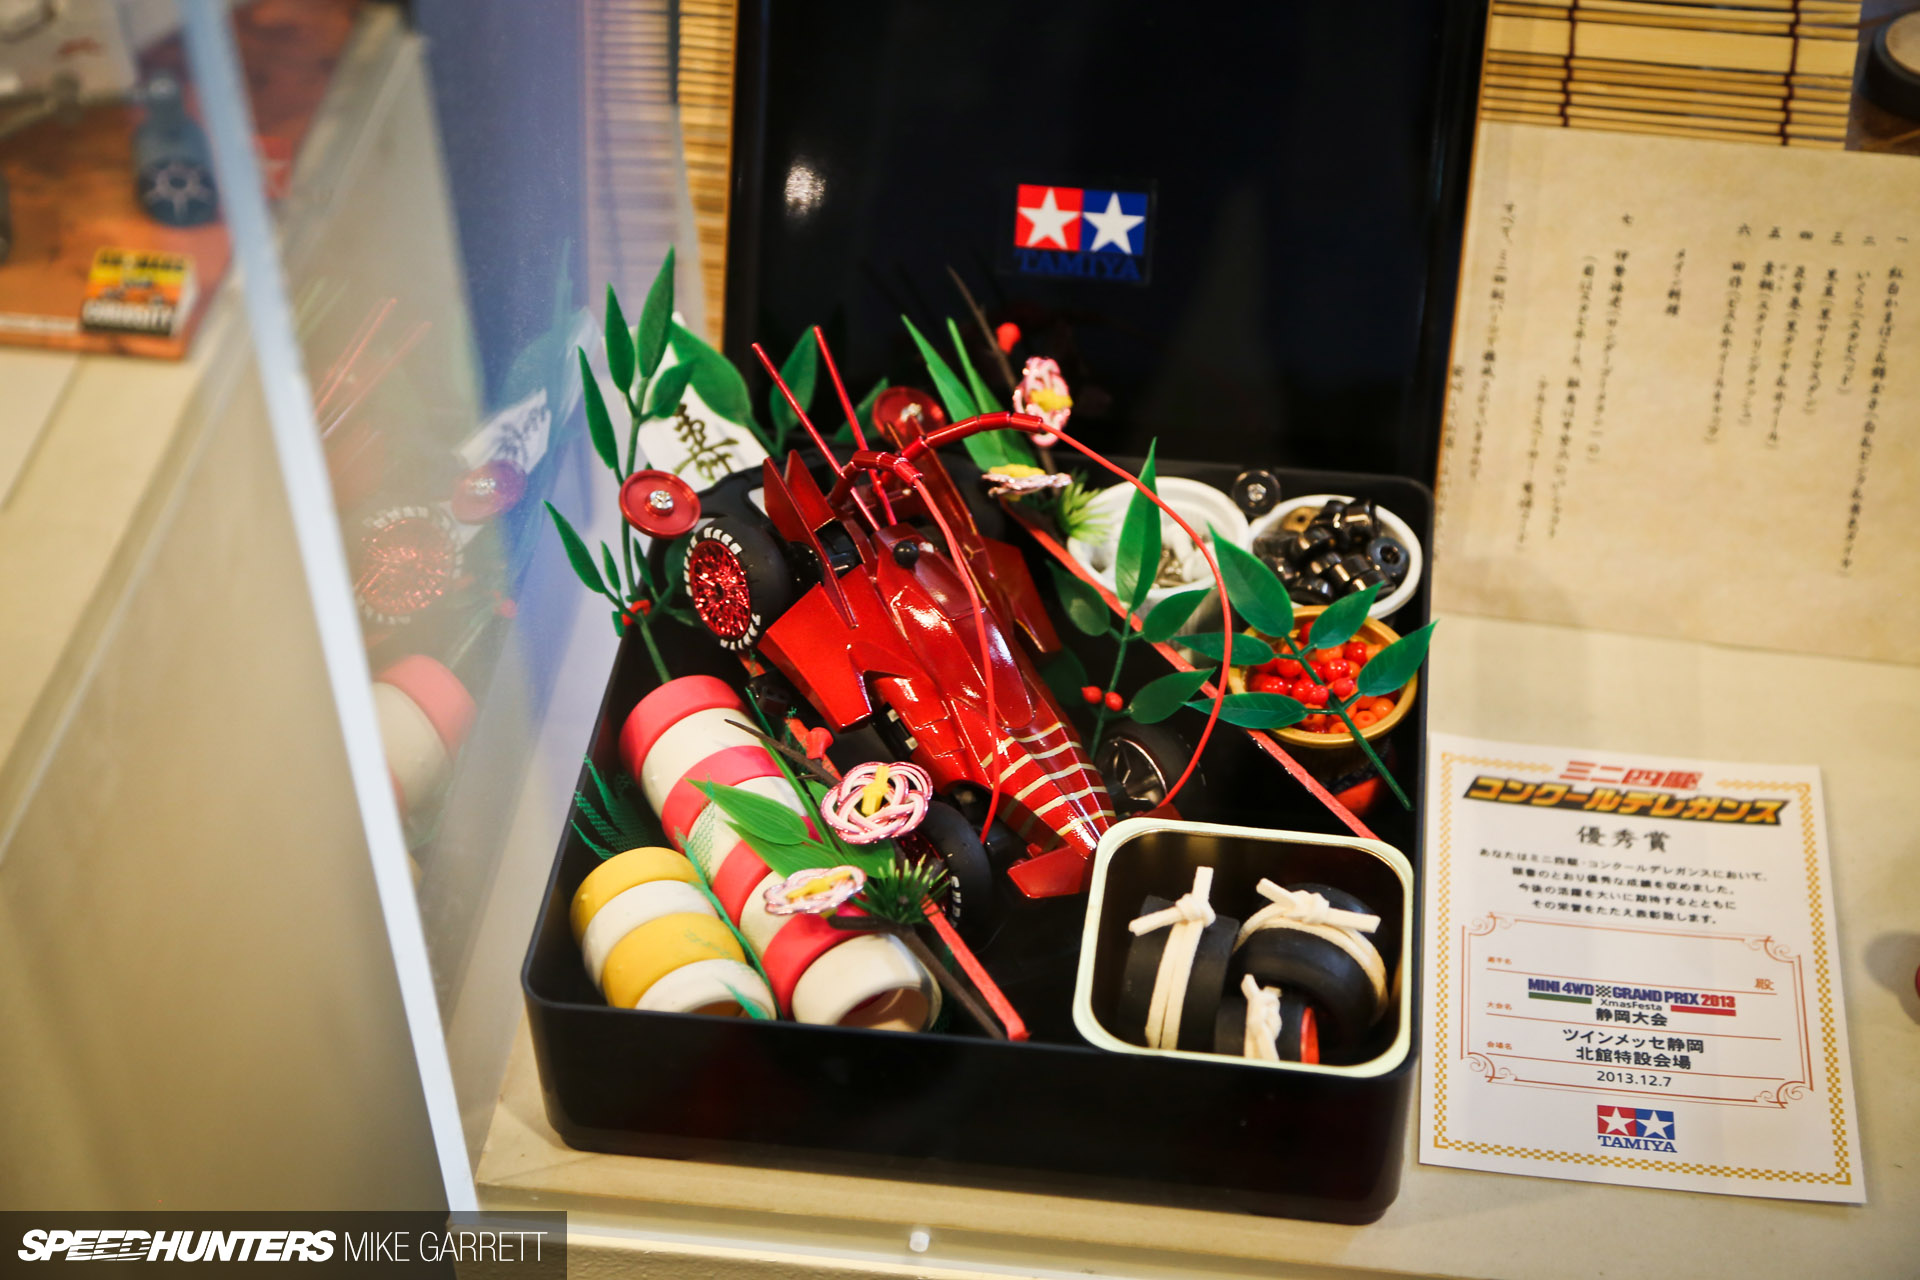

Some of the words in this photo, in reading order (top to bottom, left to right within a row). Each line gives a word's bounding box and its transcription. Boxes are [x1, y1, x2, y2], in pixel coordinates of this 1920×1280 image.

[1013, 248, 1142, 281] TAMIYA
[1466, 776, 1786, 823] コンクールデレガンス
[1577, 825, 1671, 853] 優秀賞
[1528, 978, 1560, 993] MINI
[1562, 982, 1594, 996] 4WD
[1612, 986, 1662, 1001] GRAND
[1664, 990, 1699, 1005] PRIX
[1701, 994, 1735, 1008] 2013
[1600, 998, 1662, 1011] XmasFesta
[1596, 1007, 1667, 1026] 静岡大会
[1563, 1029, 1704, 1053] ツインメッセ静岡
[1576, 1047, 1691, 1069] 北館特設会場
[1597, 1070, 1672, 1087] 2013.12.7
[1597, 1135, 1677, 1153] TAMIYA
